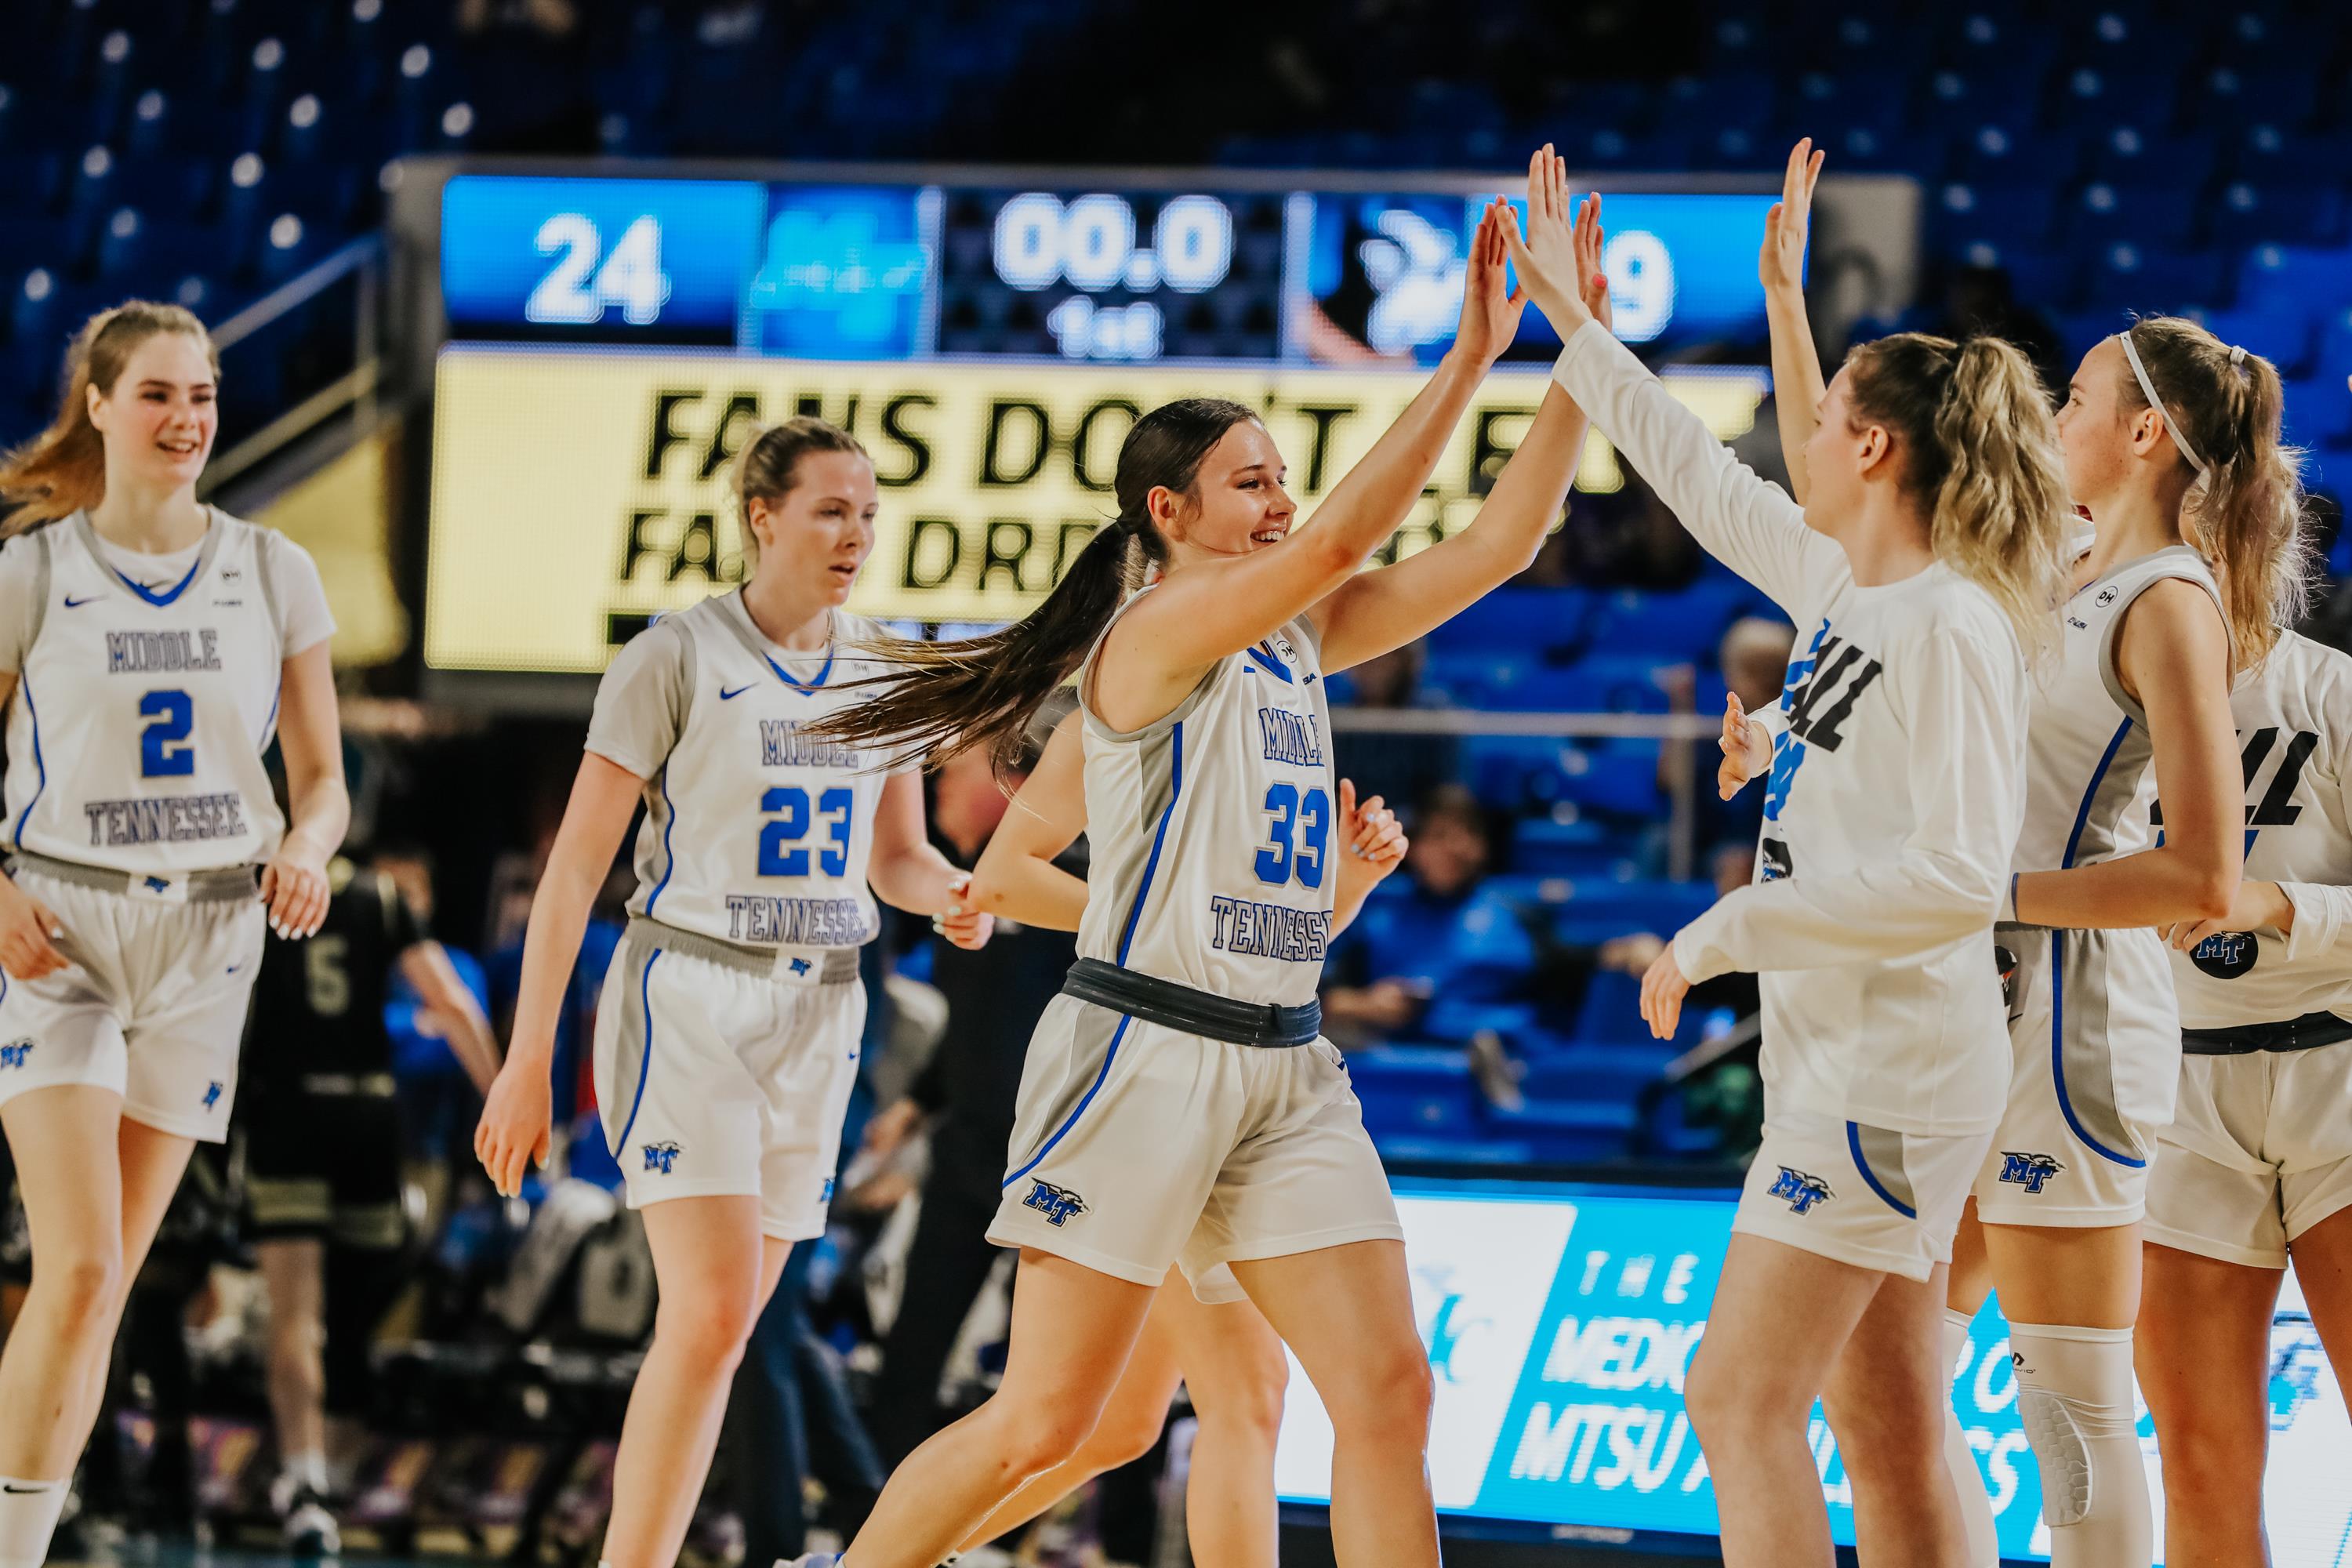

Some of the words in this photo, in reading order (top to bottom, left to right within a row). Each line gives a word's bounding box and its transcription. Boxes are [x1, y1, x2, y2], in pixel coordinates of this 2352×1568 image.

[525, 212, 671, 323] 24
[995, 192, 1233, 292] 00.0
[106, 630, 222, 673] MIDDLE
[138, 688, 194, 778] 2
[84, 793, 248, 846] TENNESSEE
[757, 786, 855, 878] 23
[1250, 779, 1331, 893] 33
[307, 935, 350, 1017] 5
[2197, 935, 2245, 965] MT
[1022, 1181, 1083, 1228] MT
[1767, 1168, 1828, 1216] MT
[1999, 1154, 2057, 1194] MT
[1578, 1250, 1700, 1305] THE
[1510, 1401, 1688, 1493] MTSU
